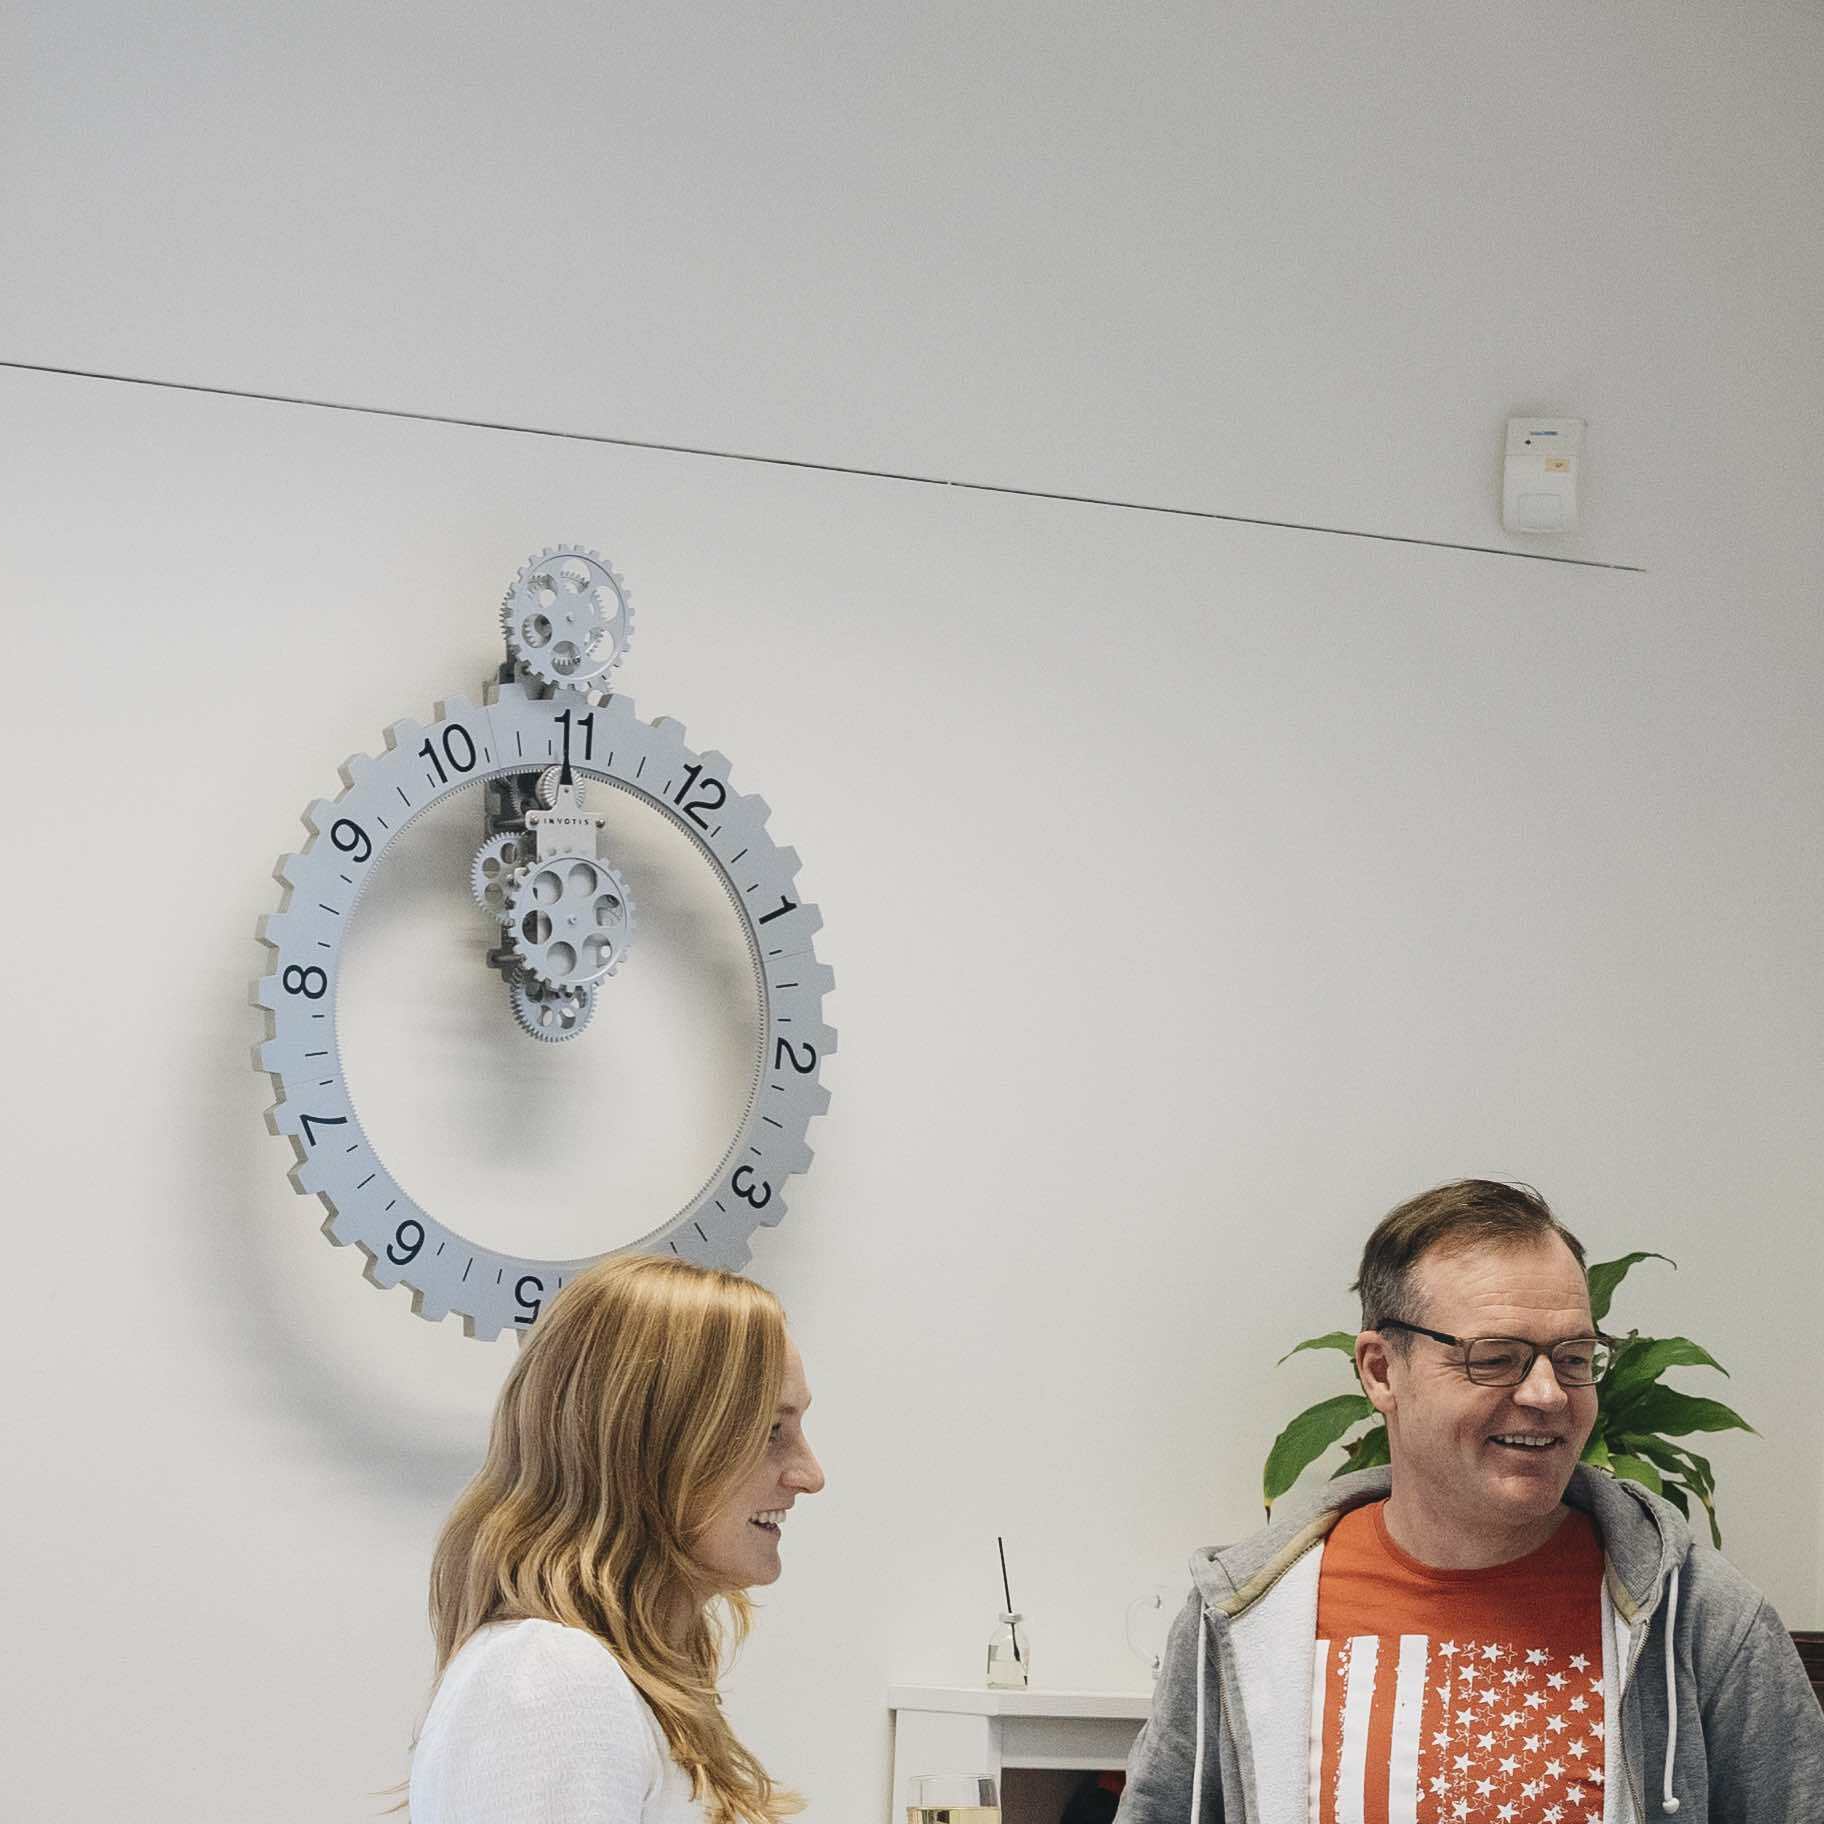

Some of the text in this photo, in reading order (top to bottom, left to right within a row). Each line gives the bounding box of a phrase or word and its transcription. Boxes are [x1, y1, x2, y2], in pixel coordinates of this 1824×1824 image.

[418, 723, 476, 784] 10
[554, 708, 594, 761] 11
[674, 763, 727, 830] 12
[330, 818, 372, 863] 9
[543, 817, 590, 826] INVOTIS
[758, 895, 797, 925] 1
[282, 964, 328, 1000] 8
[774, 1036, 818, 1074] 2
[299, 1114, 348, 1147] 7
[731, 1165, 772, 1209] 3
[386, 1219, 425, 1266] 6
[514, 1275, 544, 1325] 5
